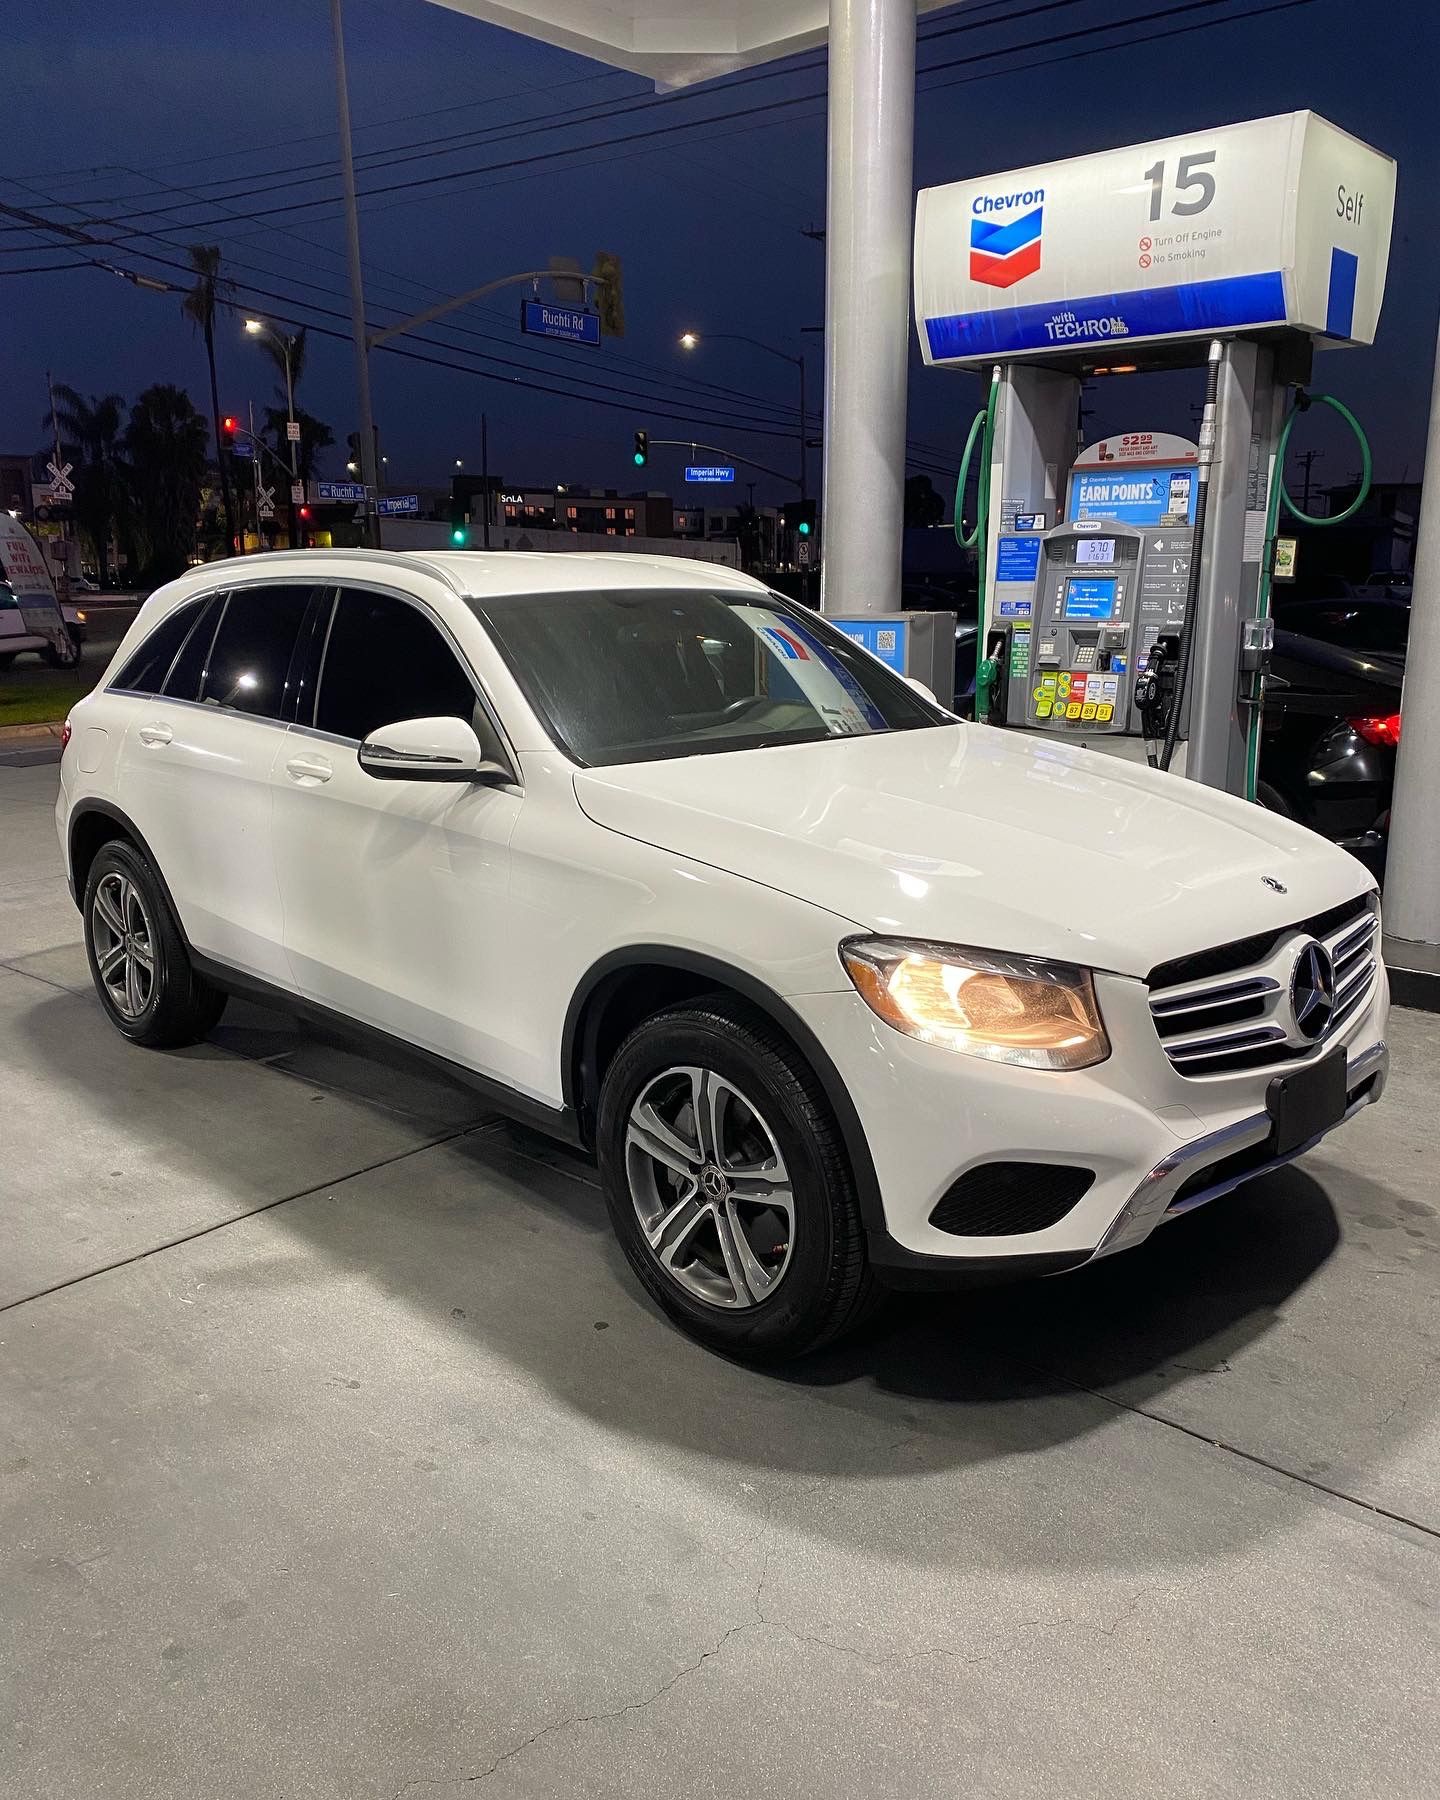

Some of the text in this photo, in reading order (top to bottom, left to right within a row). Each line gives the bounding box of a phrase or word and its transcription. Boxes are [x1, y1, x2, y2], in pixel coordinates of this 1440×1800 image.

[1144, 150, 1216, 221] 15
[972, 188, 1045, 214] Chevron
[1336, 185, 1363, 225] Self
[1154, 228, 1222, 246] Turn Off Engine
[1153, 248, 1206, 264] No Smoking
[542, 310, 583, 330] Ruchti Rd
[1052, 312, 1075, 323] with
[1044, 317, 1121, 339] TECHRON
[691, 469, 729, 477] Imperial Hwy
[331, 486, 354, 498] Ruchti
[1080, 484, 1153, 501] EARN POINTS
[387, 498, 409, 511] Imperial
